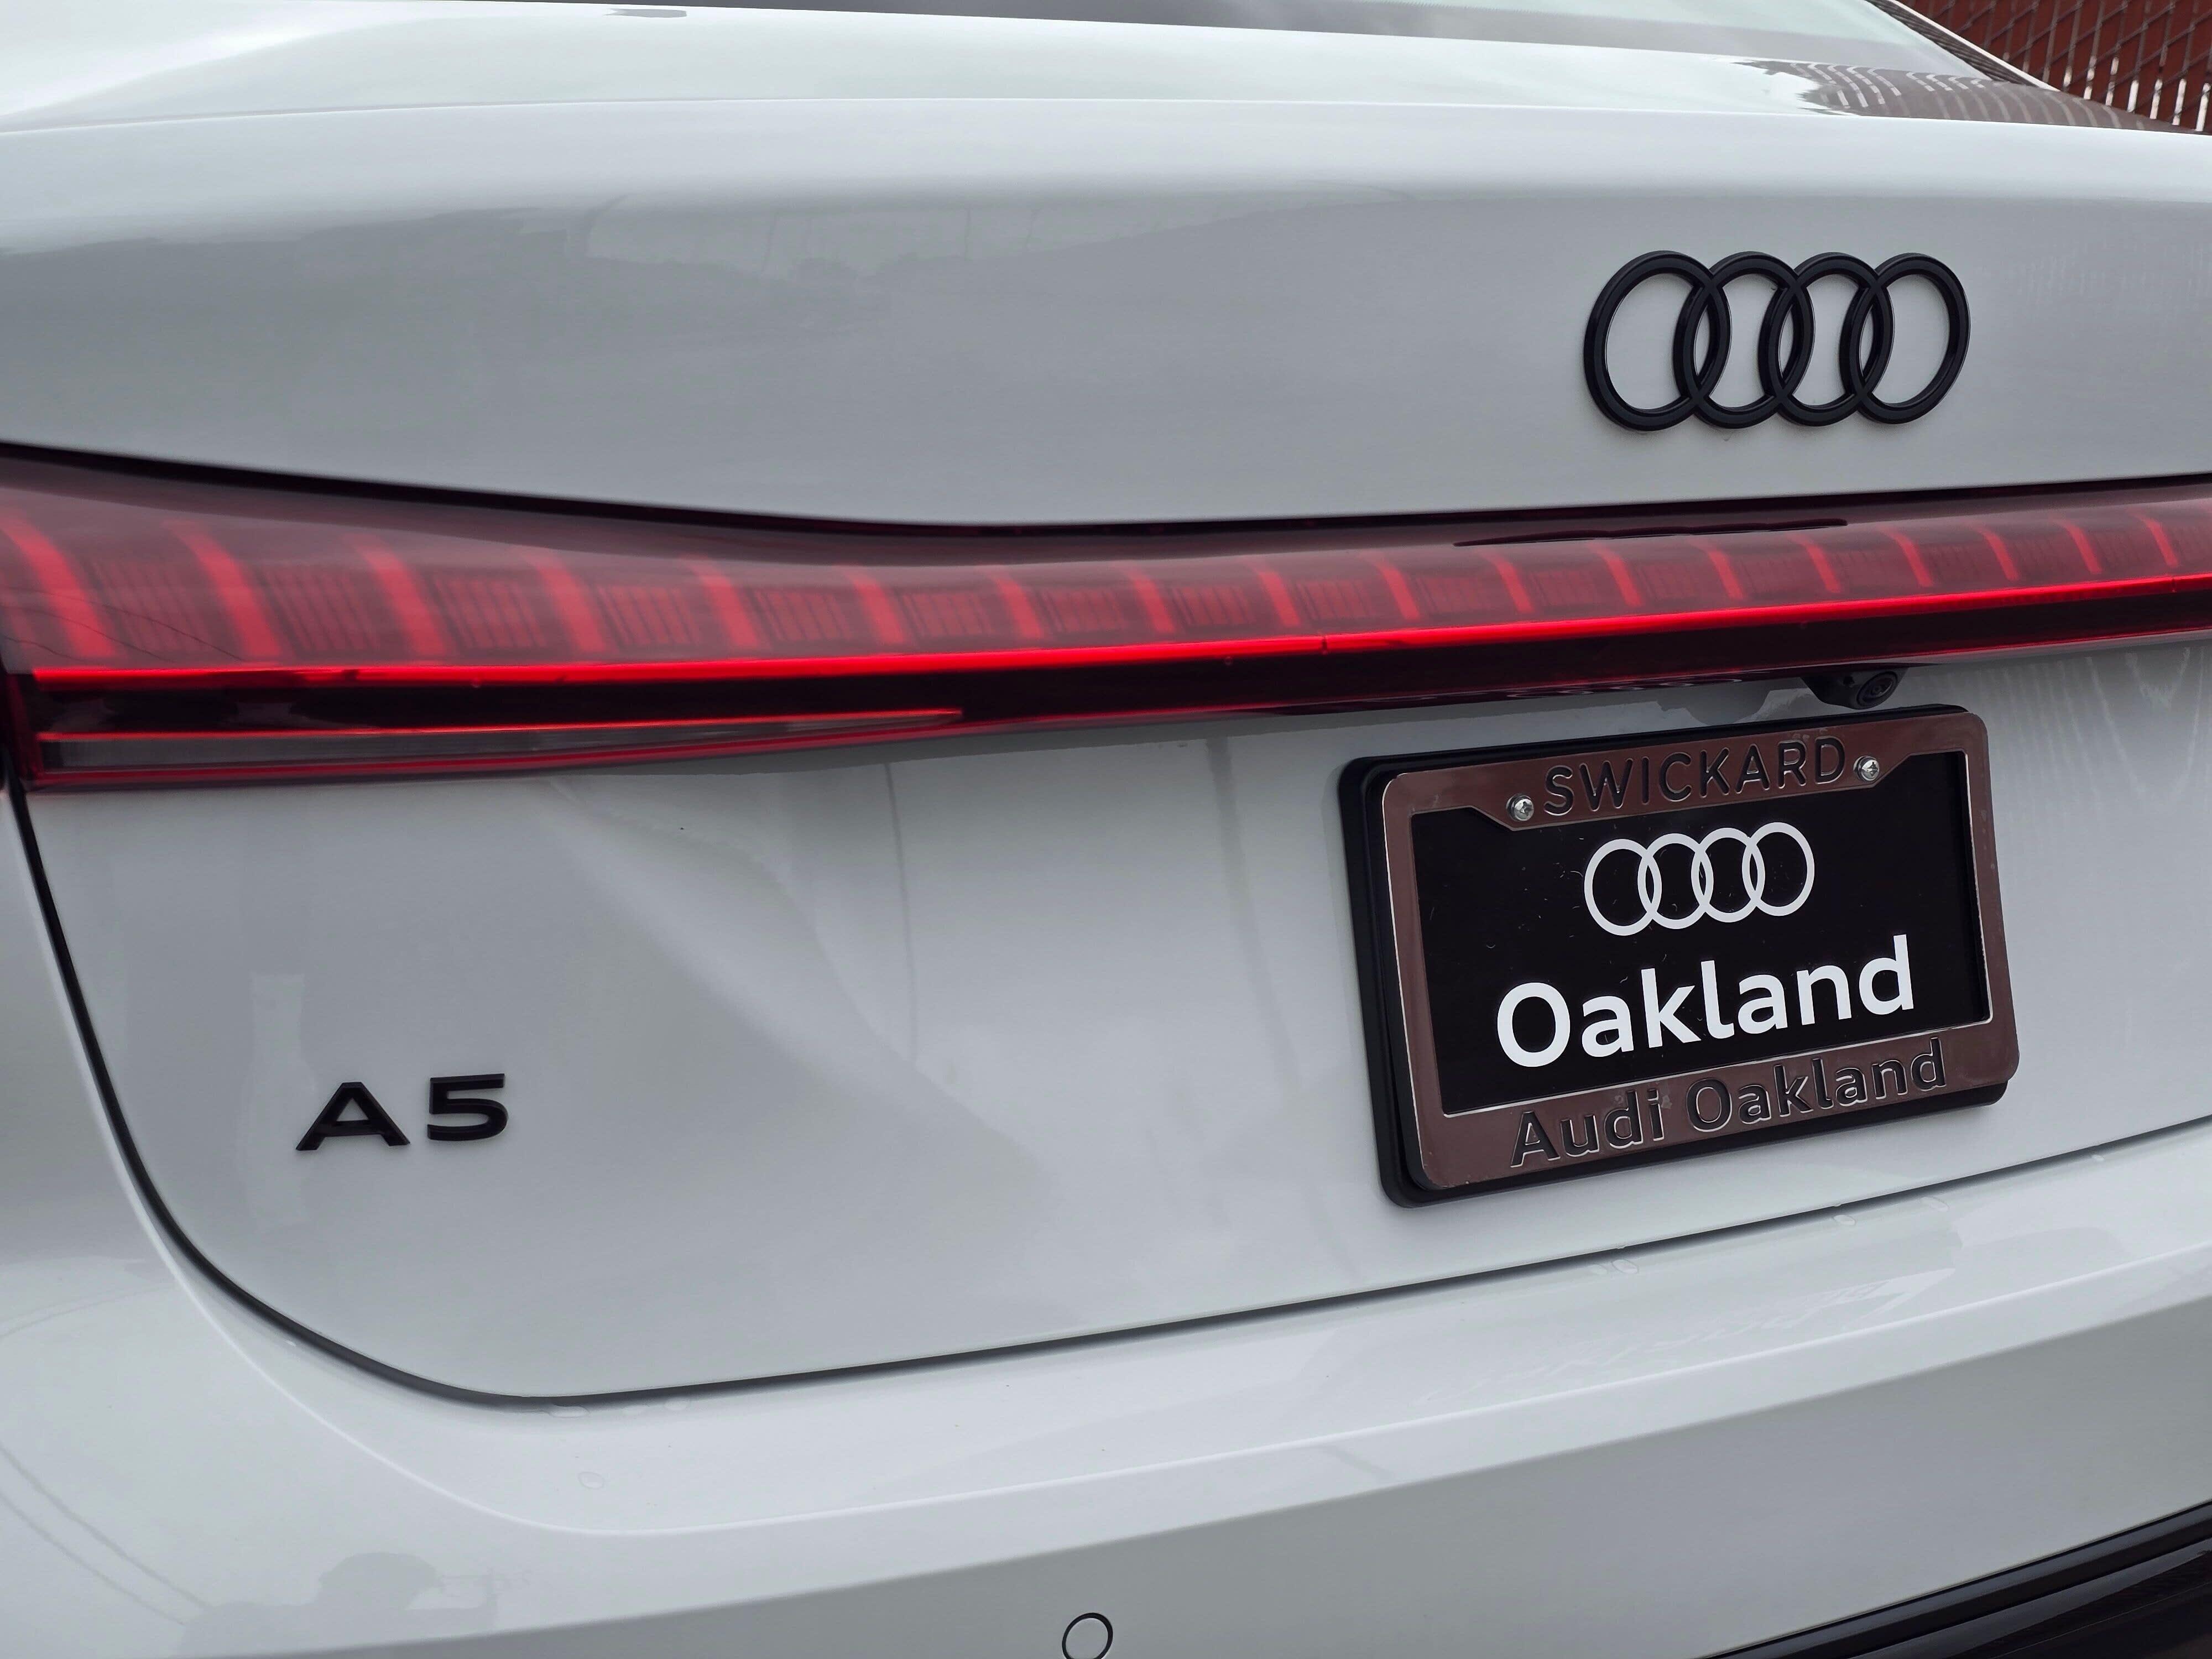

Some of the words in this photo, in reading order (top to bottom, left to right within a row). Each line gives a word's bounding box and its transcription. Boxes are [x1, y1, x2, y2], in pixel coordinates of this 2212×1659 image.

[1543, 737, 1846, 816] SWICKARD
[1497, 935, 1914, 1067] Oakland
[296, 1073, 508, 1151] A5
[1510, 1089, 1665, 1167] Audi
[1684, 1038, 1947, 1132] Oakland
